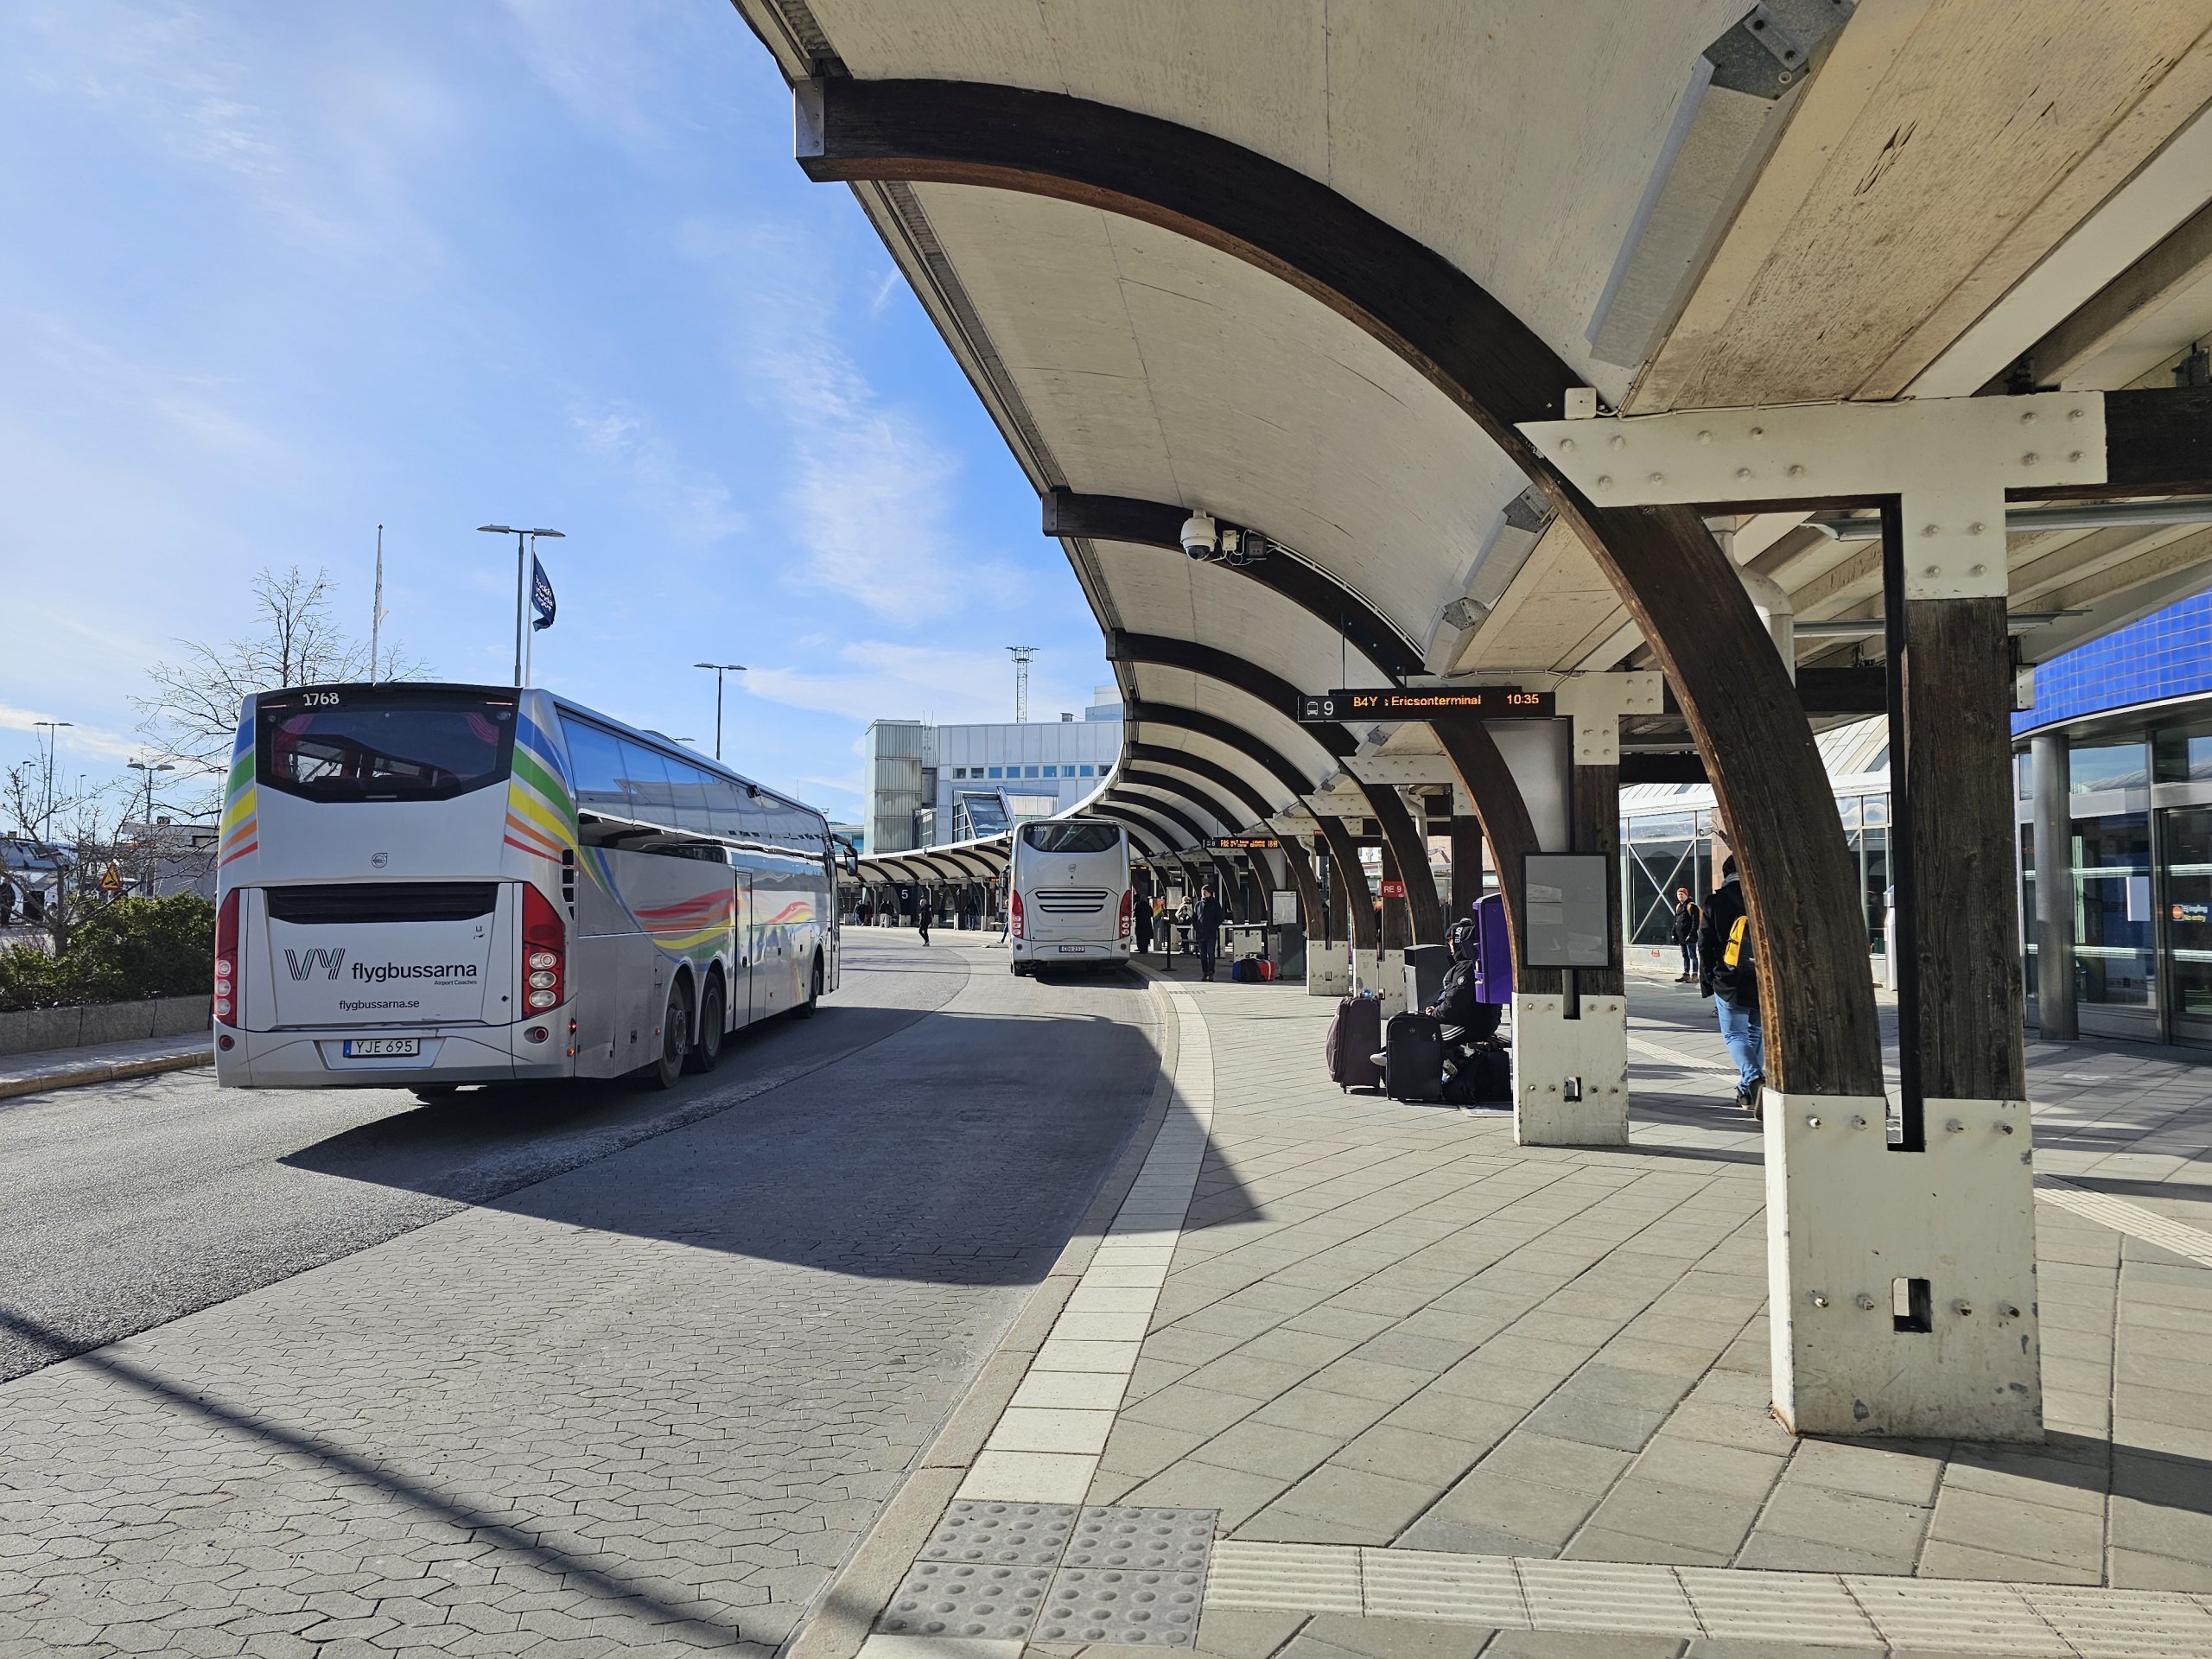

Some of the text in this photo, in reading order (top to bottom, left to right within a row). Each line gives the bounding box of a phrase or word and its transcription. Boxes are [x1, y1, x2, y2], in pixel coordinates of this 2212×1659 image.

[302, 692, 340, 706] 1768
[1324, 701, 1334, 715] 9
[1353, 696, 1378, 707] B4Y
[1391, 695, 1482, 707] Ericsonterminal
[1507, 694, 1539, 705] 10:35
[901, 889, 908, 899] 5
[283, 947, 346, 981] VY
[351, 963, 477, 983] flygbussarna
[339, 1000, 420, 1011] flygbussarna.se
[356, 1040, 413, 1053] YJE 695
